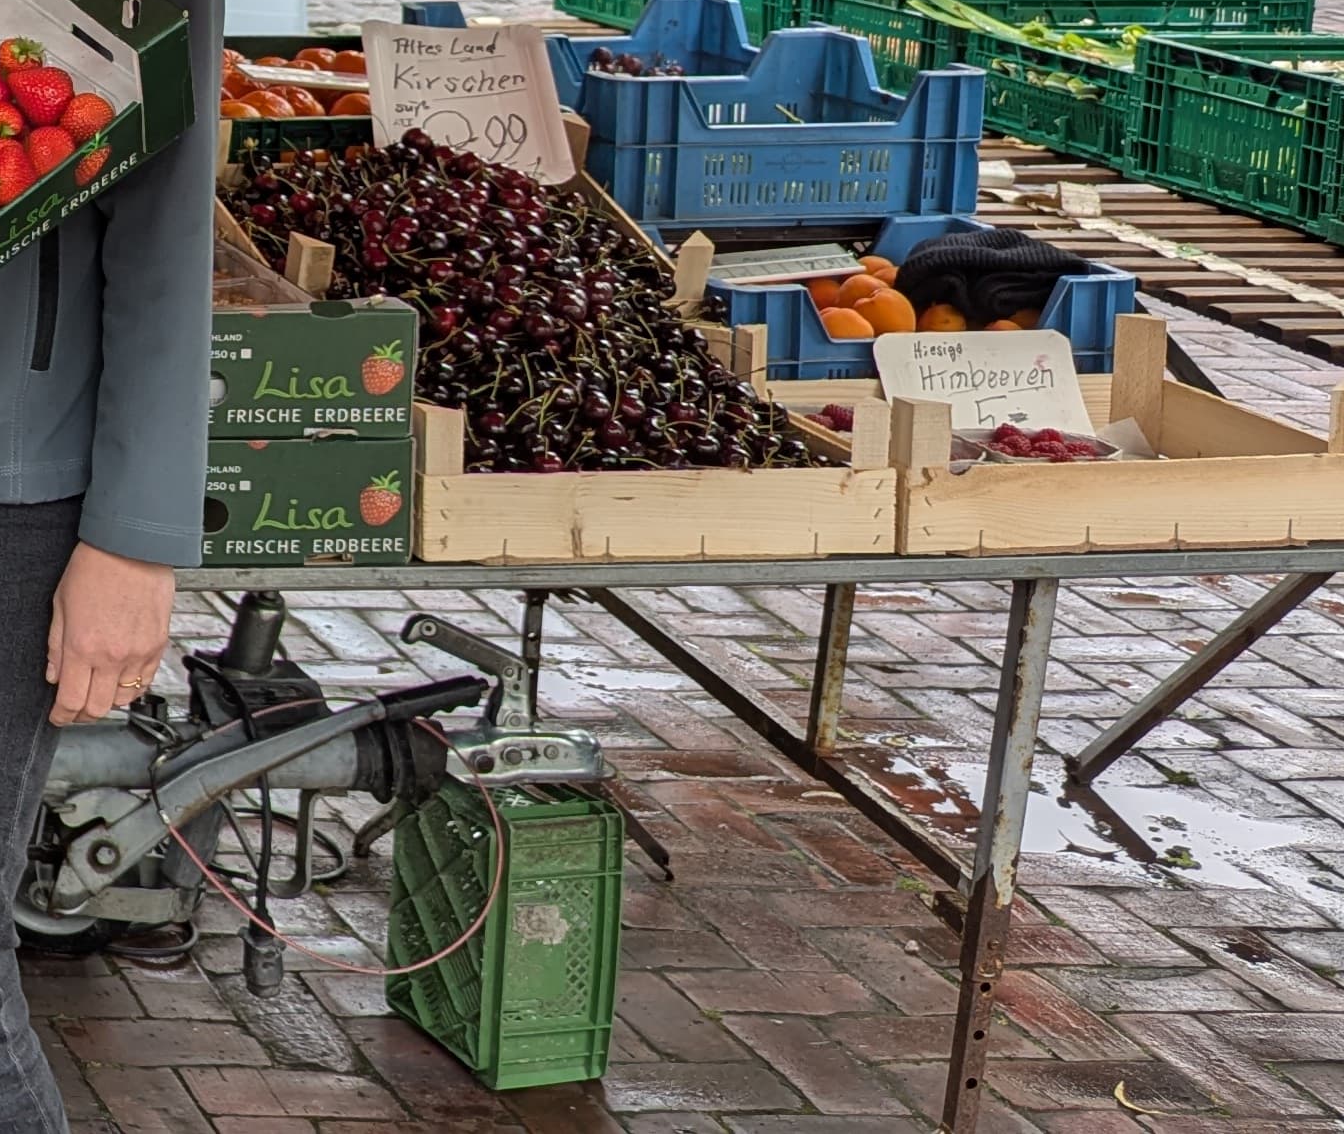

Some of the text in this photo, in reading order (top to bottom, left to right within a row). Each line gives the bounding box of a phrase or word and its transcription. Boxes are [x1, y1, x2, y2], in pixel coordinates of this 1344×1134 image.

[392, 31, 499, 56] Altes Land
[393, 63, 526, 93] Kirschen
[61, 152, 138, 218] ERDBEERE
[253, 361, 356, 400] Lisa
[919, 361, 1055, 391] Himbeeren
[227, 408, 302, 423] FRISCHE
[314, 407, 407, 423] ERDBEERE
[207, 481, 236, 492] 250 g
[252, 493, 355, 530] Lisa
[226, 539, 301, 554] FRISCHE
[313, 537, 405, 553] ERDBEERE
